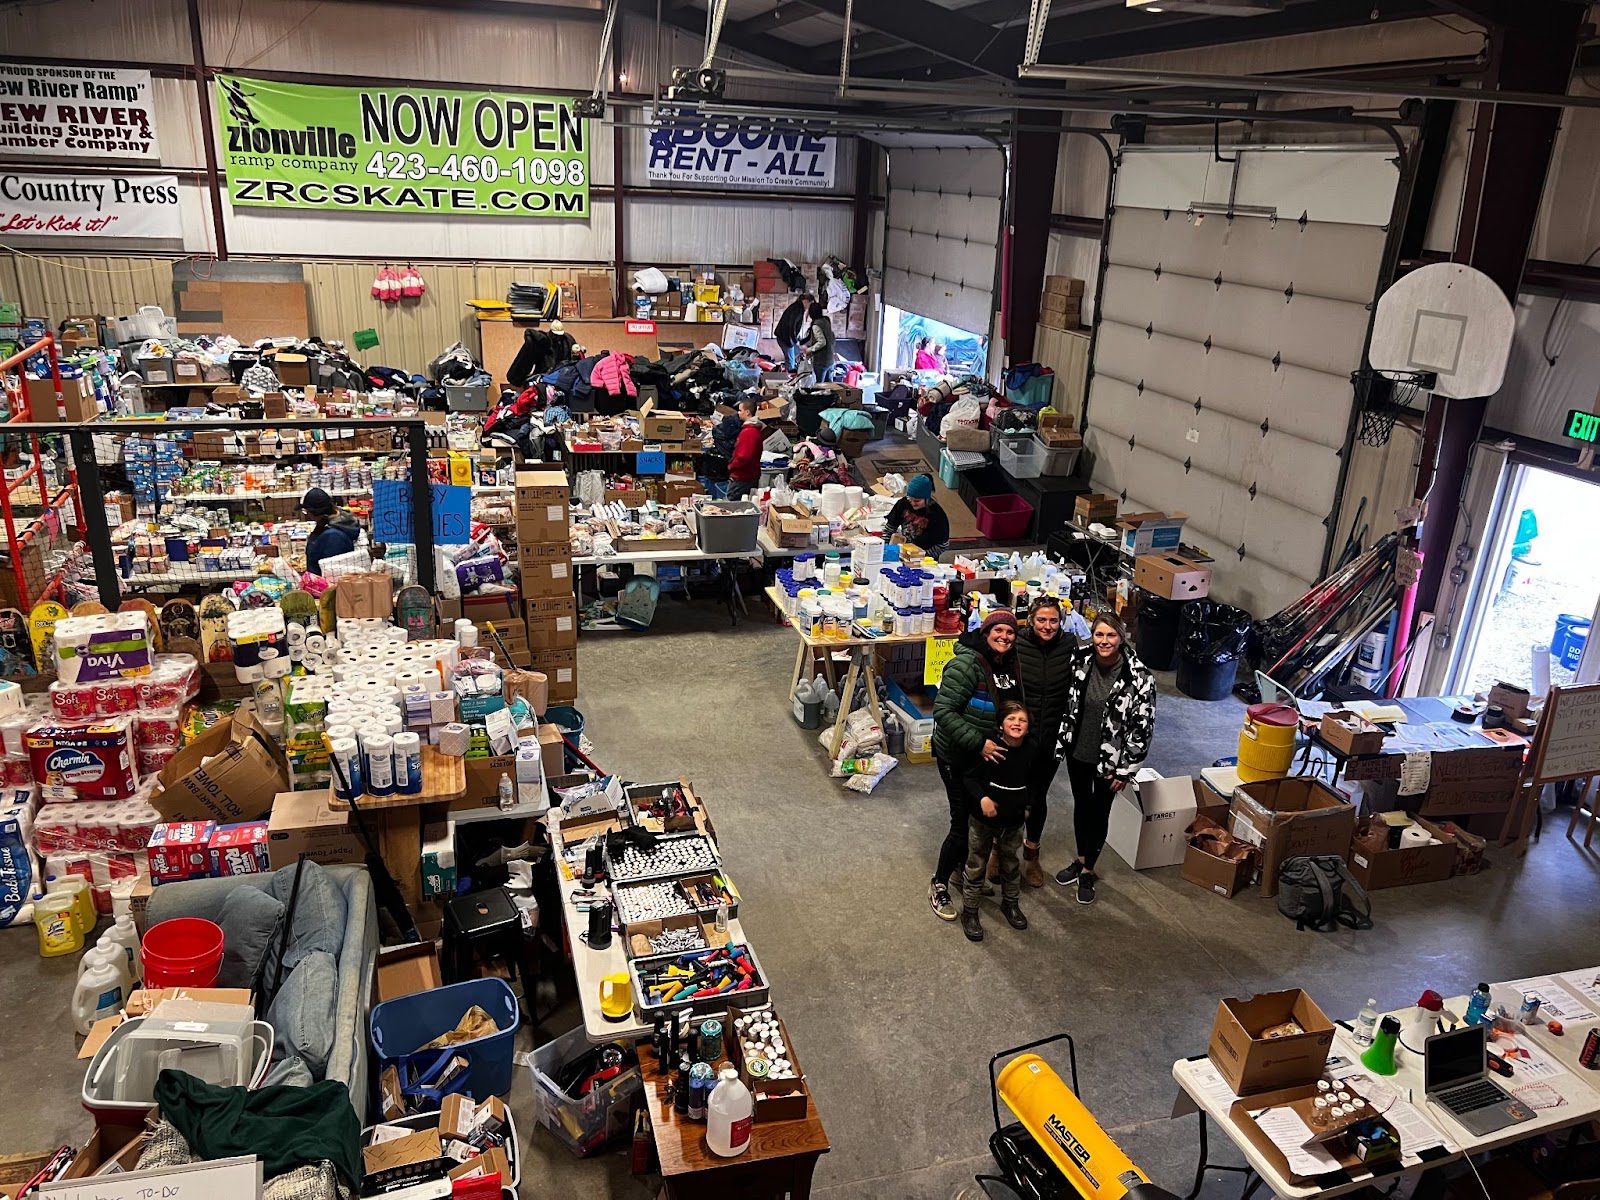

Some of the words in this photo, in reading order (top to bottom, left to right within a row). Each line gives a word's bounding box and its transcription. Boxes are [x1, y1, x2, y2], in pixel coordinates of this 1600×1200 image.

[0, 66, 34, 78] PROUD
[36, 67, 83, 79] SPONSOR
[84, 69, 97, 79] OF
[98, 70, 116, 80] THE
[28, 79, 78, 99] River
[0, 103, 47, 122] EW
[57, 105, 150, 128] RIVER
[360, 93, 461, 146] NOW
[474, 97, 584, 152] OPEN
[68, 125, 133, 140] Supply
[138, 126, 154, 140] &
[227, 124, 357, 159] zionville
[64, 136, 150, 153] Company
[230, 156, 275, 171] ramp
[281, 156, 359, 175] company
[366, 151, 585, 186] 423-460-1098
[649, 147, 742, 172] RENT
[764, 152, 826, 177] ALL
[648, 171, 667, 179] Thank
[694, 173, 728, 183] Supporting
[728, 175, 740, 183] Our
[741, 176, 765, 184] Mission
[774, 177, 794, 185] Create
[0, 175, 105, 211] Country
[112, 178, 178, 205] Press
[234, 180, 584, 212] ZRCSKATE.COM
[46, 215, 81, 232] Kick
[1569, 412, 1600, 442] EXIT
[399, 488, 447, 504] BBY
[1568, 645, 1581, 655] DO
[87, 653, 125, 669] Viva
[50, 753, 91, 770] Charmin
[80, 769, 102, 777] Strong
[181, 776, 201, 795] B&W
[220, 793, 244, 817] ROLL
[1153, 811, 1176, 820] TARGET
[0, 846, 16, 876] Tissue
[2, 875, 20, 903] Bath
[1048, 1113, 1091, 1164] MASTER
[136, 1185, 181, 1200] TO-DO
